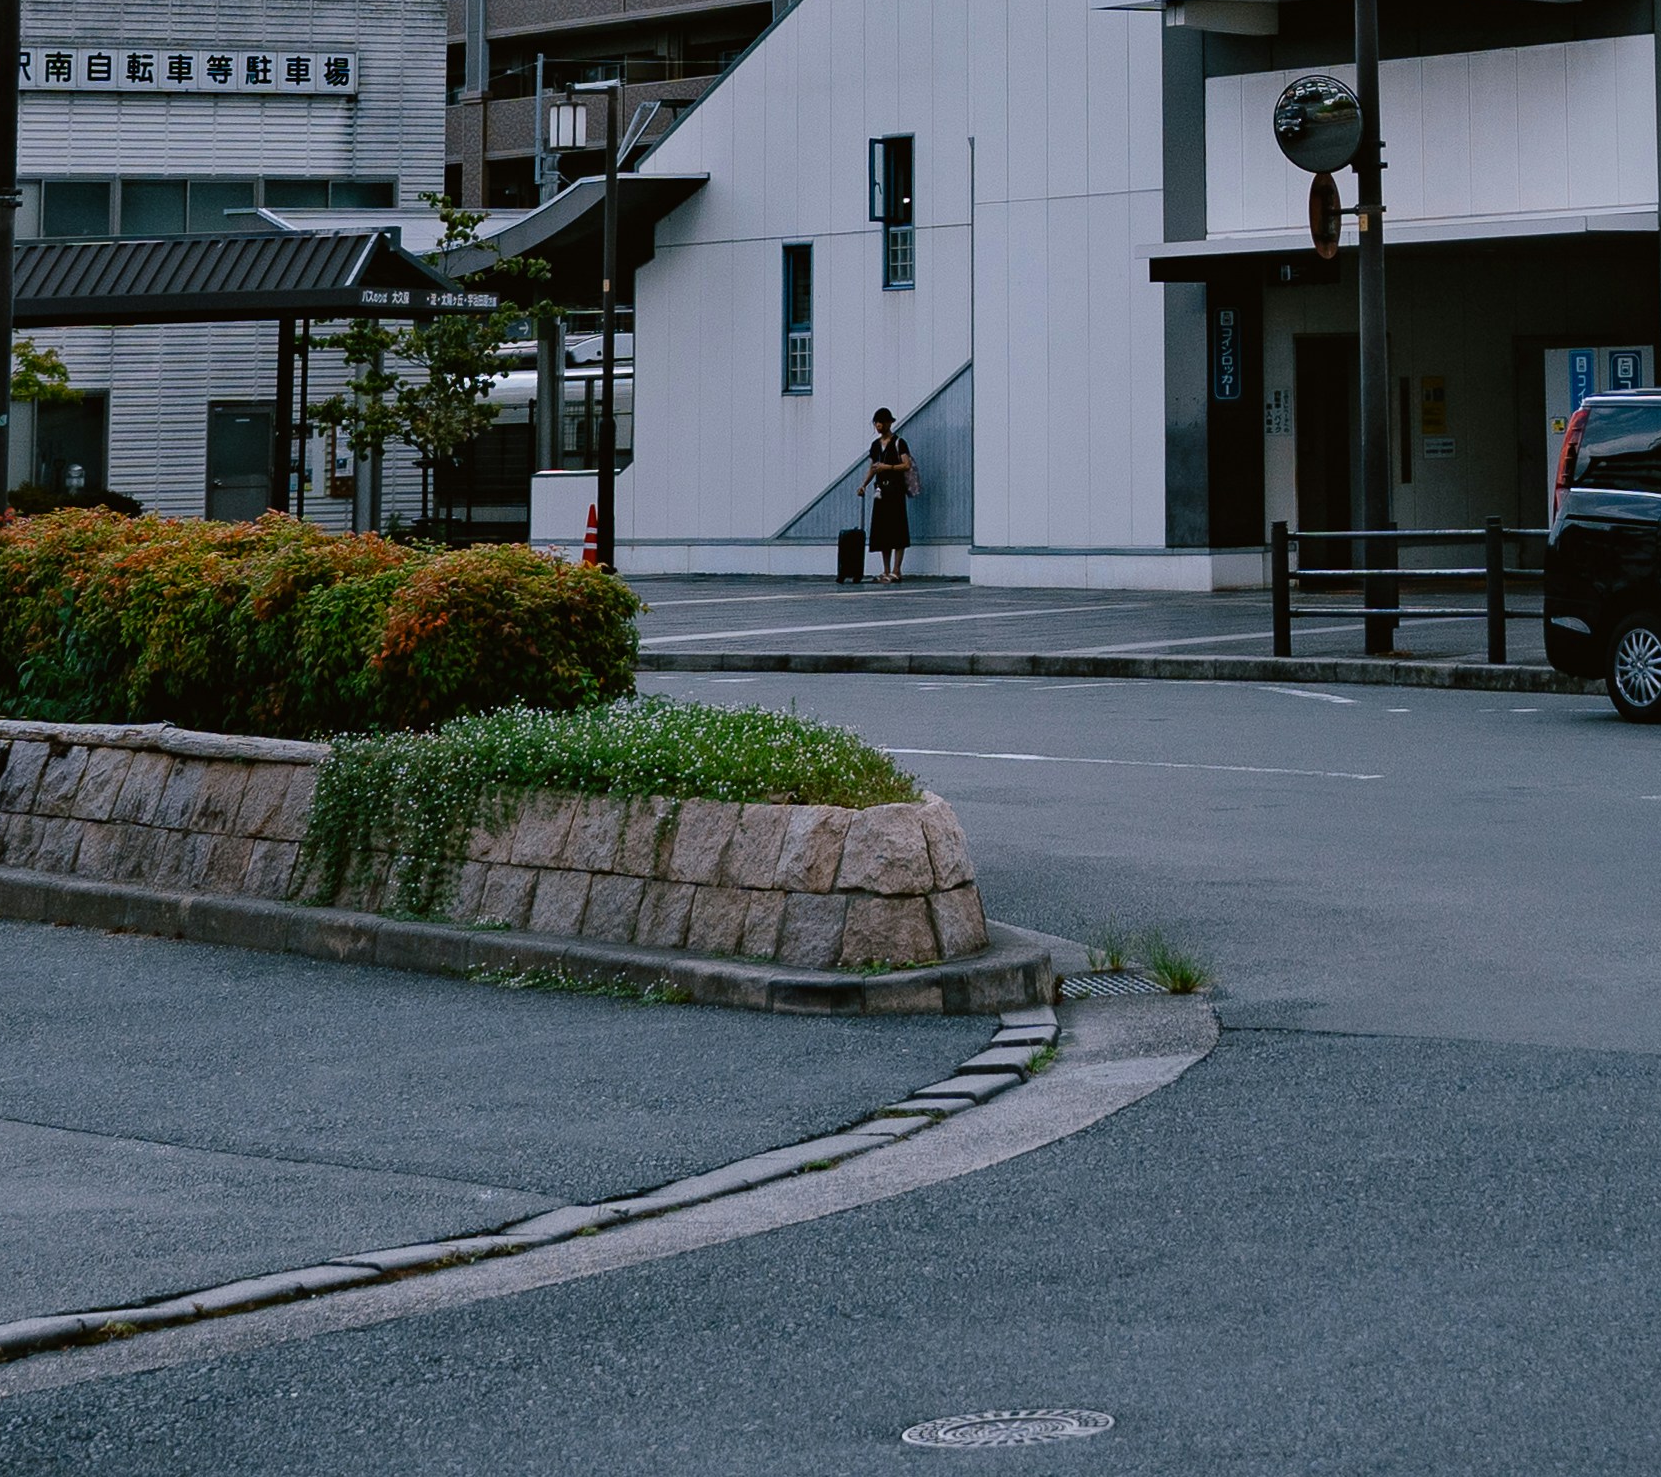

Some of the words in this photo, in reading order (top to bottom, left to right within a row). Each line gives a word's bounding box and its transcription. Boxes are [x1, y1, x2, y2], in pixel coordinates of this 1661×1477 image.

[1221, 328, 1234, 395] コインロッカー
